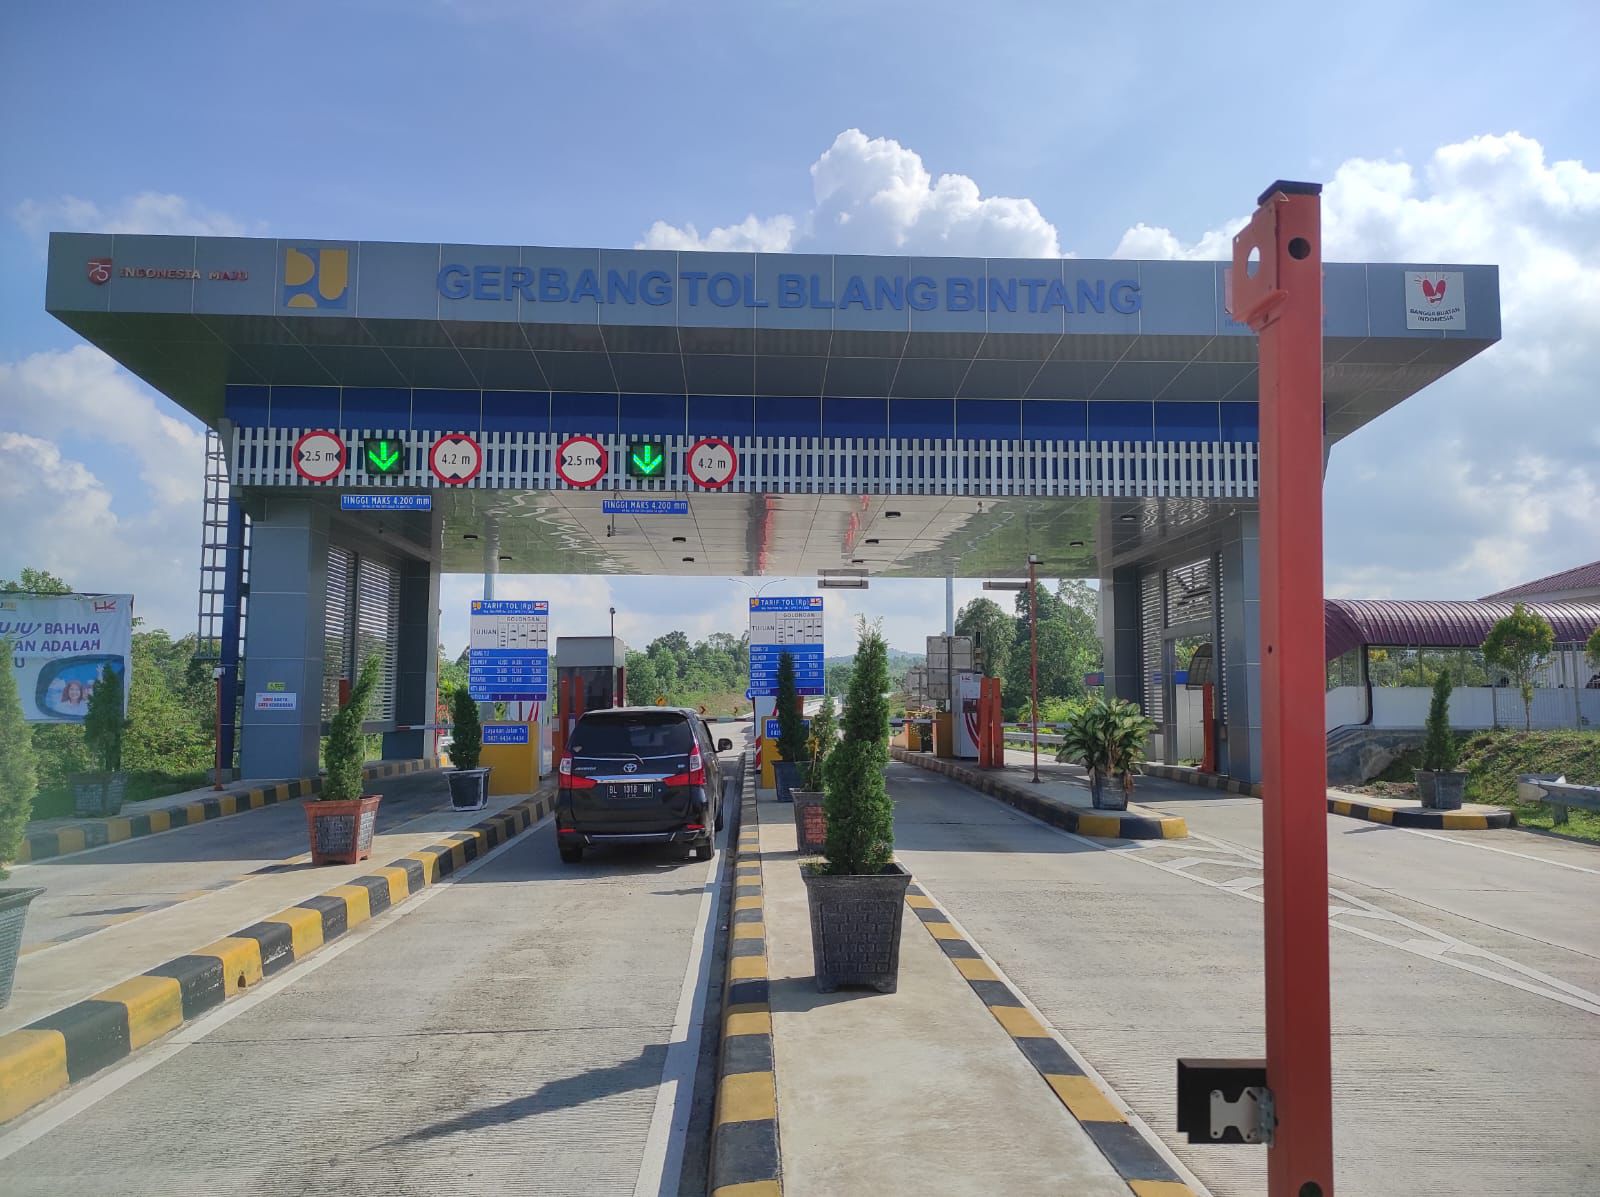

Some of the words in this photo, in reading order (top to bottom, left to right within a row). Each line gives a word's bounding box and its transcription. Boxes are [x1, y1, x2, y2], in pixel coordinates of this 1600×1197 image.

[120, 266, 200, 279] INDONESIA
[436, 263, 673, 306] GERBANG
[680, 271, 768, 308] TOL
[777, 274, 938, 311] BLANG
[945, 277, 1142, 314] BINTANG
[305, 451, 321, 462] 2.5
[325, 453, 334, 462] m
[441, 453, 457, 464] 4.2
[462, 455, 471, 464] m
[567, 455, 582, 466] 2.5
[585, 457, 595, 466] m
[698, 458, 713, 469] 4.2
[717, 459, 726, 469] m
[343, 496, 368, 504] TINGGI
[372, 496, 391, 505] MAKS
[394, 496, 413, 505] 4.200
[416, 497, 430, 505] mm
[604, 500, 628, 508] TINGGI
[630, 501, 649, 509] MAKS
[651, 501, 671, 509] 4.200
[674, 502, 688, 510] mm
[44, 623, 100, 634] BAHWA
[40, 640, 100, 651] ADALAH
